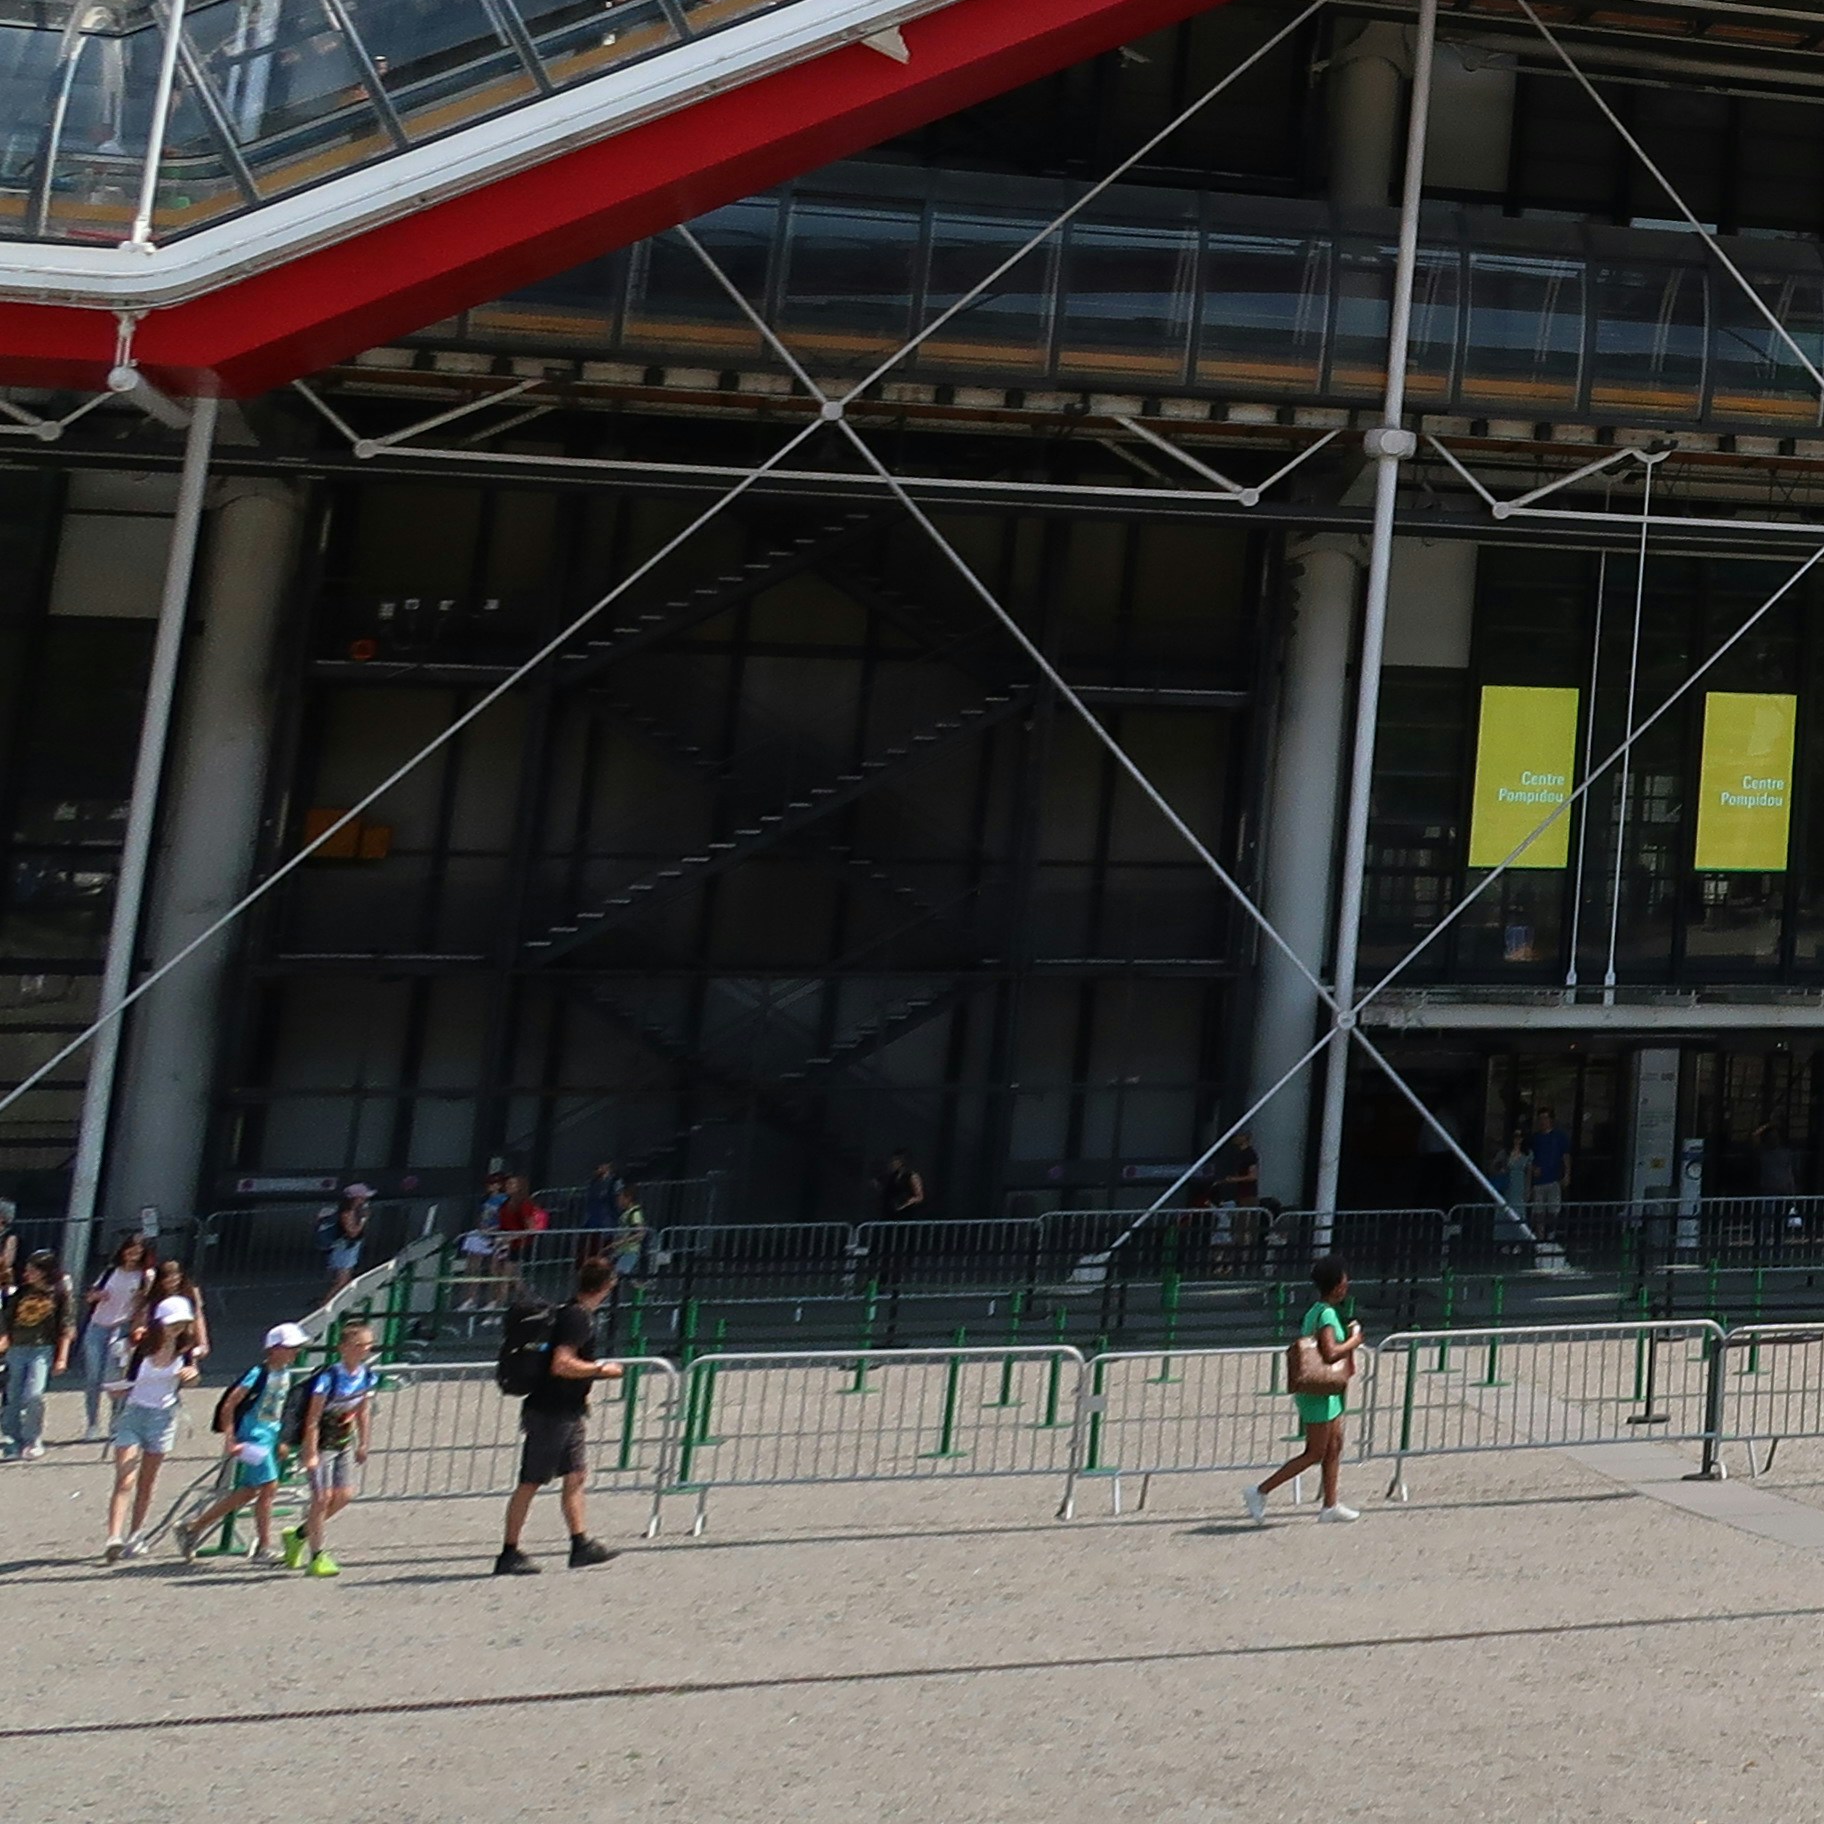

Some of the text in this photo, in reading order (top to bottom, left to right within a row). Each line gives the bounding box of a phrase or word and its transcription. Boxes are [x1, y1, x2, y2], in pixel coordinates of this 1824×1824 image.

[1521, 771, 1565, 785] Centre
[1743, 775, 1785, 790] Centre
[1498, 788, 1563, 805] Pompidou
[1720, 791, 1783, 808] Pompidou
